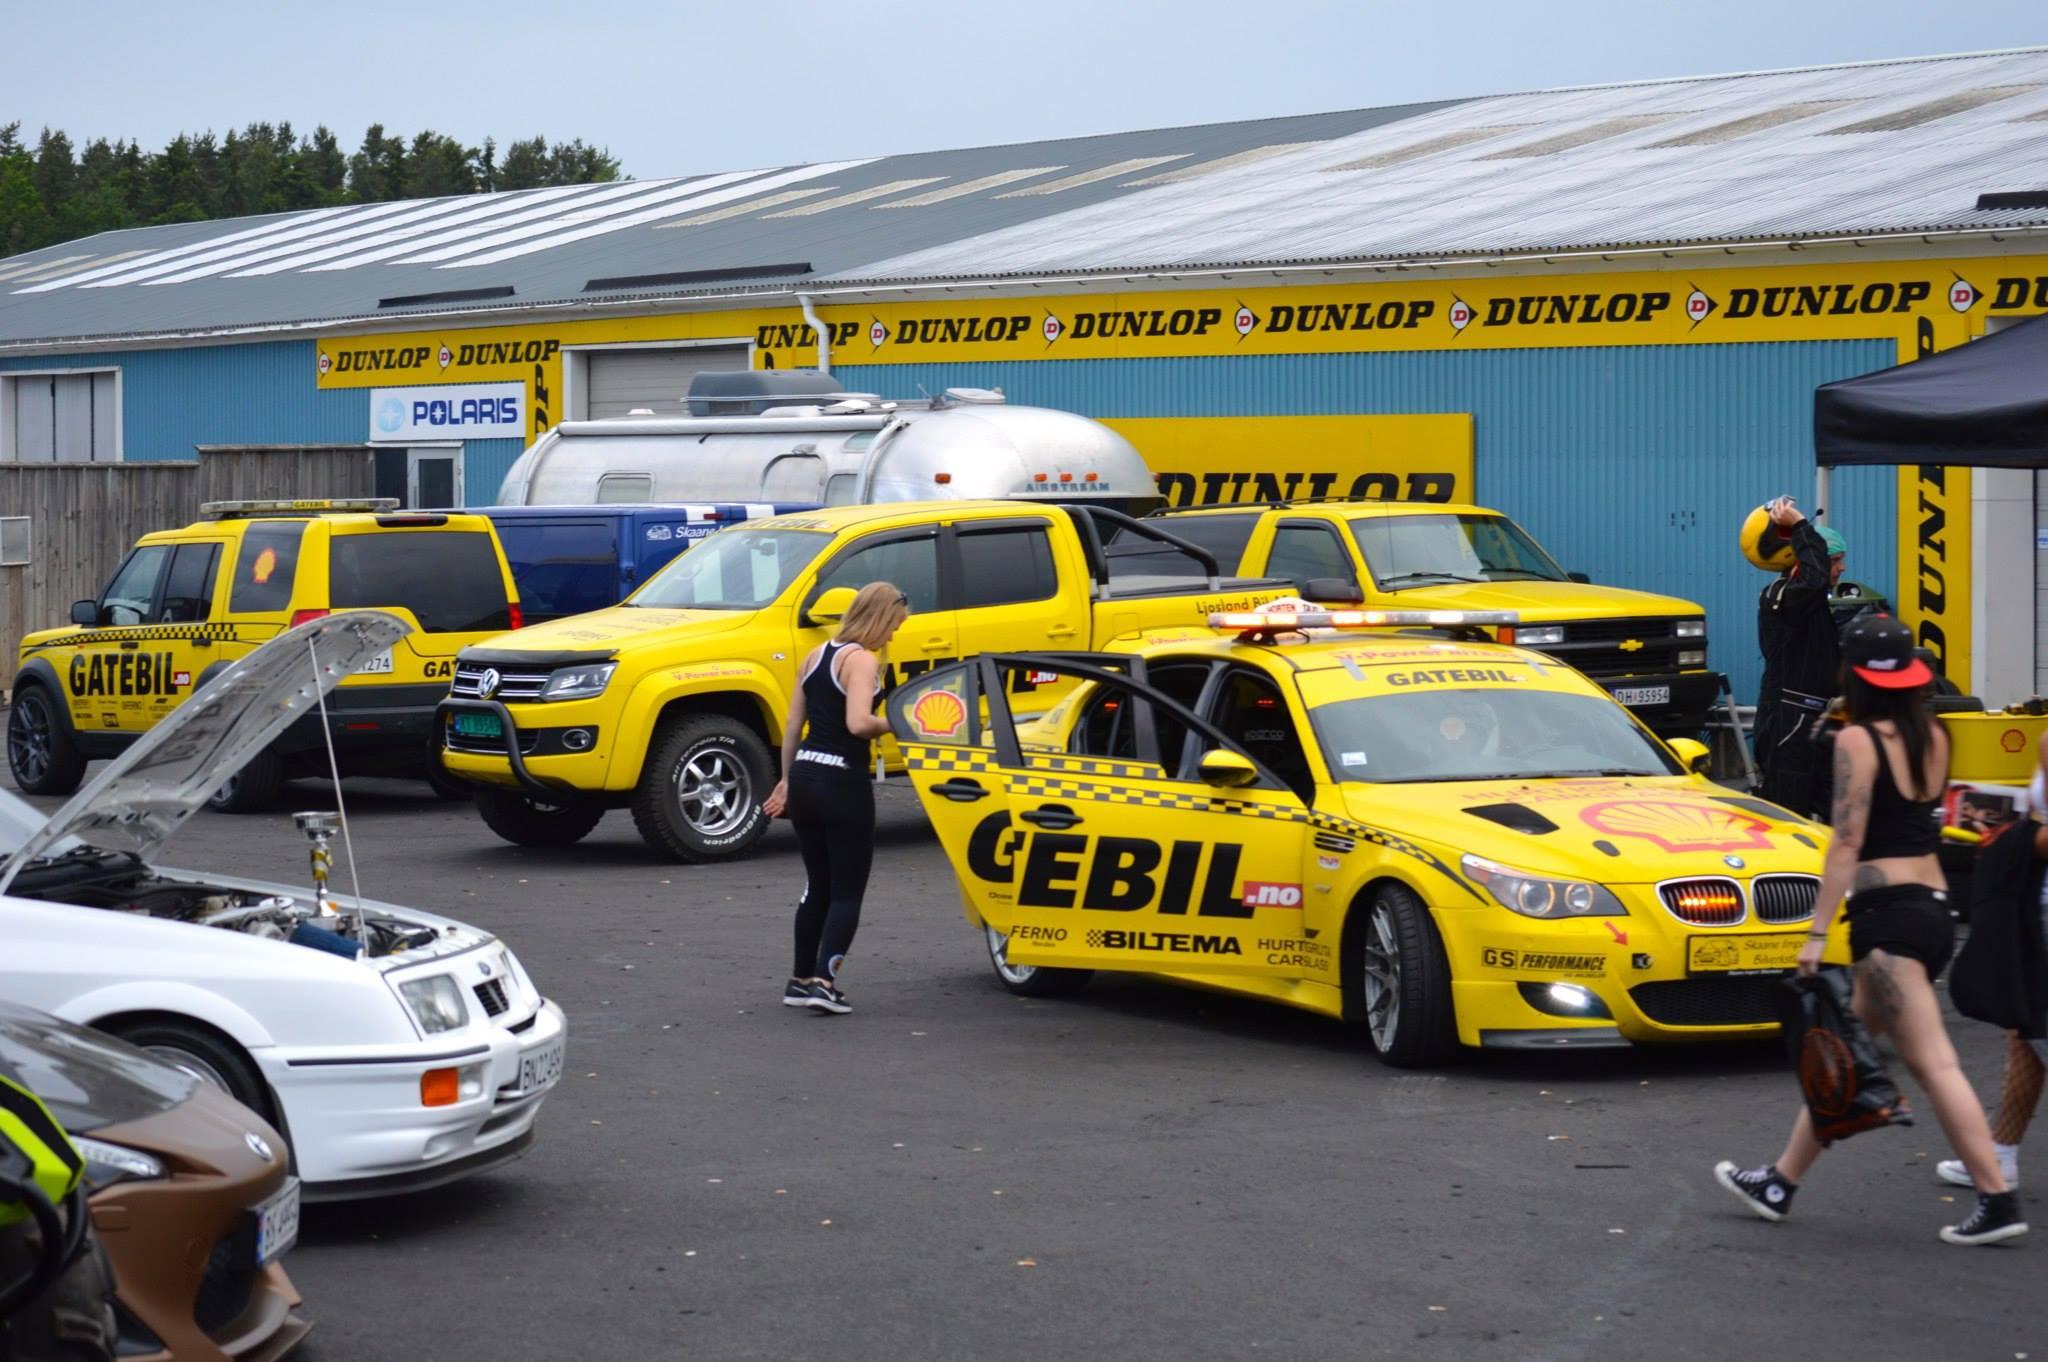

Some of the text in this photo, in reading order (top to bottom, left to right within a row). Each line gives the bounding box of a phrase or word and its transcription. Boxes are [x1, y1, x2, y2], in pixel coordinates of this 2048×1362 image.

[894, 315, 1031, 344] DUNLOP
[1069, 308, 1221, 340] DUNLOP
[1265, 301, 1434, 333] DUNLOP
[1483, 292, 1670, 326] DUNLOP
[1723, 281, 1931, 318] DUNLOP
[335, 347, 430, 372] DUNLOP
[456, 340, 560, 366] DUNLOP
[413, 397, 518, 426] POLARIS
[1025, 482, 1110, 492] AIRSTREAM
[1196, 598, 1249, 616] Ljosland
[69, 652, 178, 697] GATEBIL
[1386, 669, 1517, 686] GATEBIL
[1010, 925, 1068, 941] FERNO
[1101, 930, 1243, 955] BILTEMA
[1521, 953, 1606, 971] PERFORMANCE
